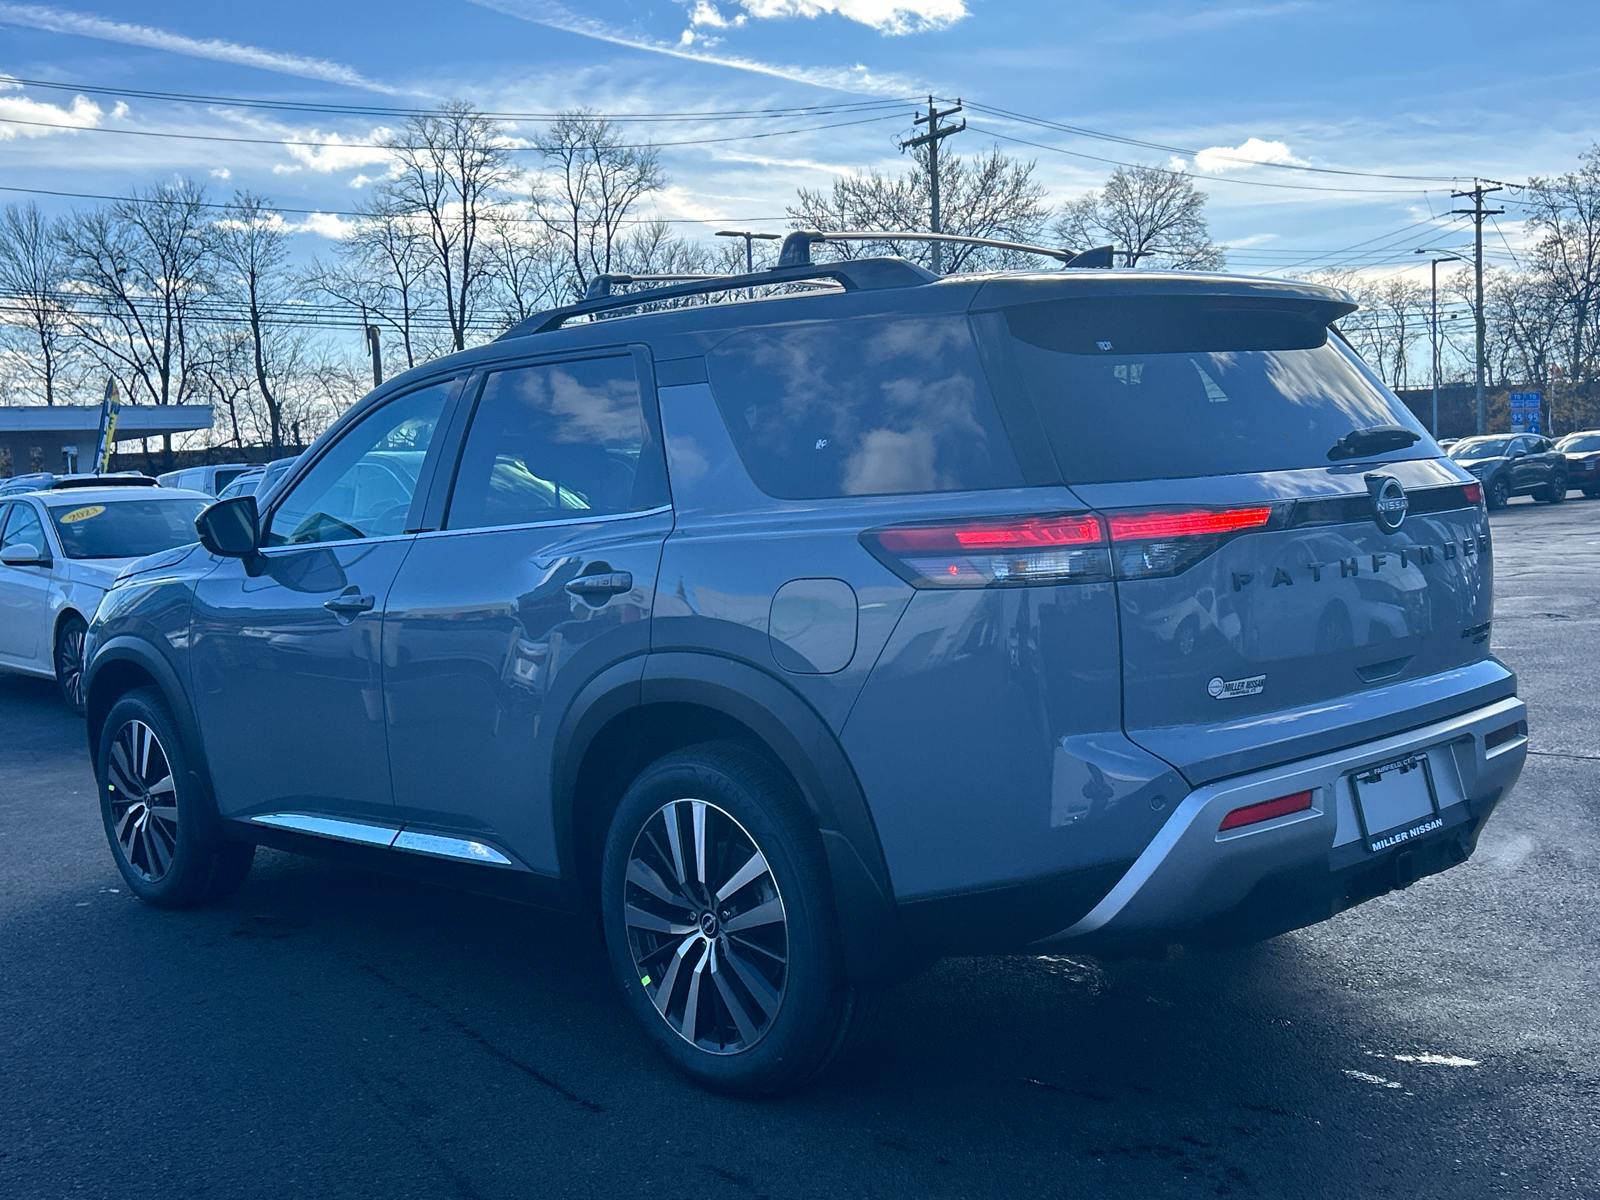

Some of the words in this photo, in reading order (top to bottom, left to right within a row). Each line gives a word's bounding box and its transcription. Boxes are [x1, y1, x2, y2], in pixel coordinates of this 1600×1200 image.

[69, 507, 98, 521] 2023
[1377, 500, 1408, 511] NISSAN
[1231, 534, 1487, 592] PATHFINDER
[1372, 831, 1409, 852] MILLER
[1409, 818, 1443, 838] NISSAN
